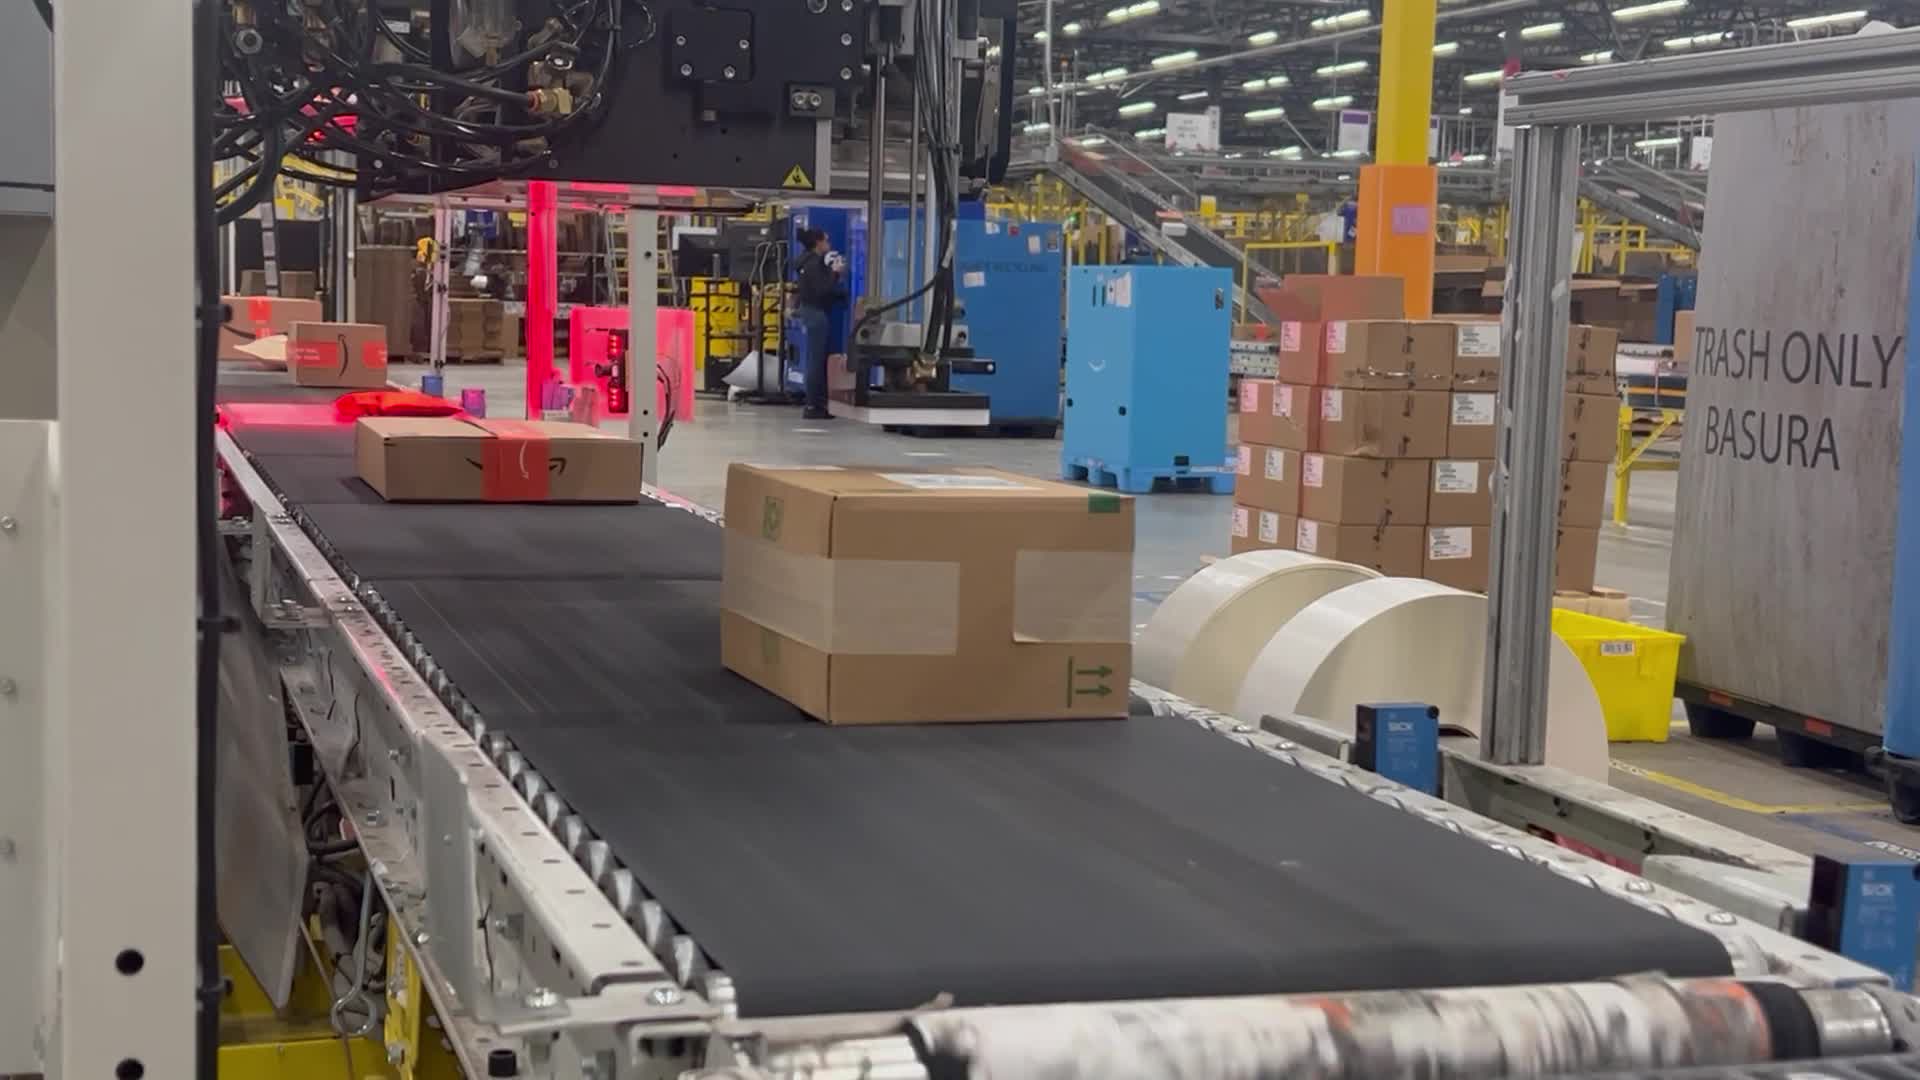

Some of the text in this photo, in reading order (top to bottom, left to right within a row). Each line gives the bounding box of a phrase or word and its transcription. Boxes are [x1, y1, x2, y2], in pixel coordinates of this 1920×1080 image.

[1695, 326, 1903, 390] TRASH ONLY
[1704, 404, 1841, 471] BASURA
